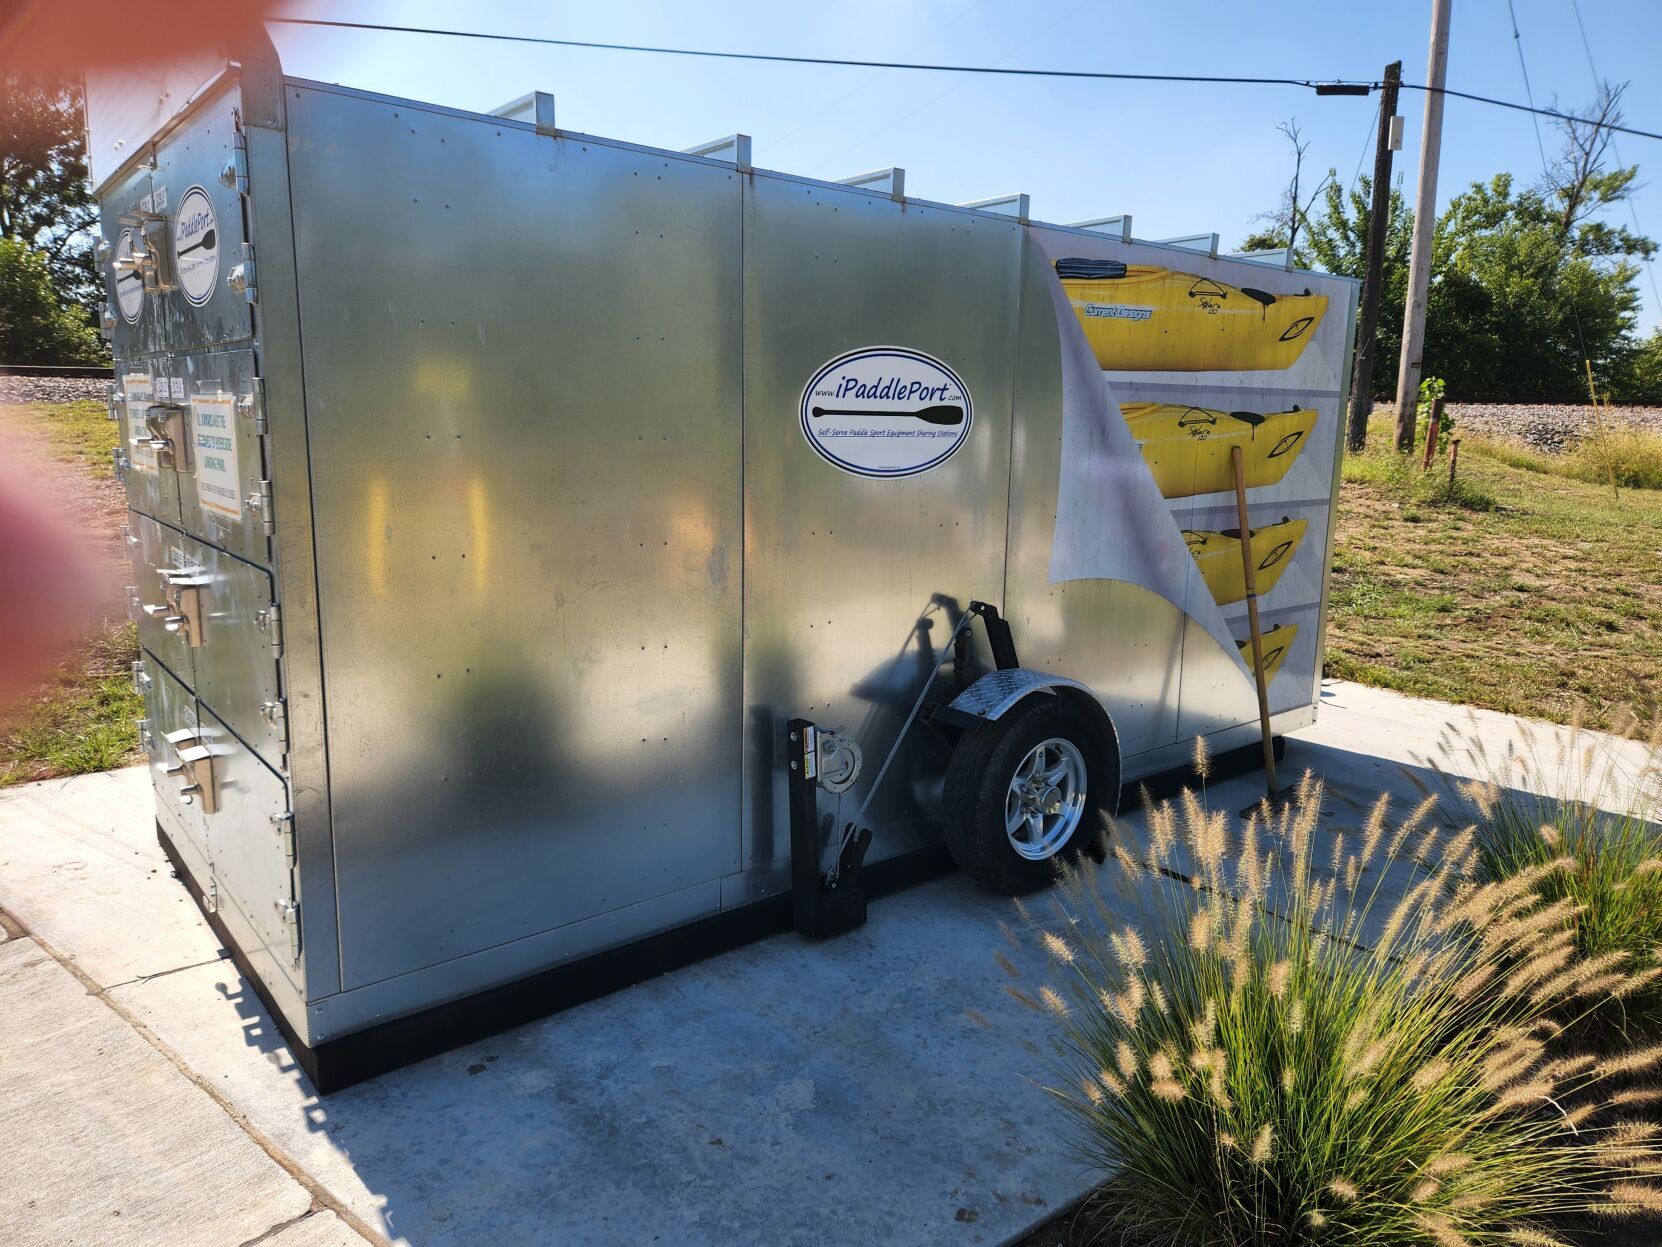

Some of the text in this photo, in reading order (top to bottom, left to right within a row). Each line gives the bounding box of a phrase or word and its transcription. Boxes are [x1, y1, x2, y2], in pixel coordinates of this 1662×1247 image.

[1085, 303, 1152, 320] Current Designs
[815, 389, 835, 397] www.
[835, 375, 949, 402] iPaddlePort
[817, 428, 958, 438] Self-Serve Paddle Sport Equipment Sharing Stations
